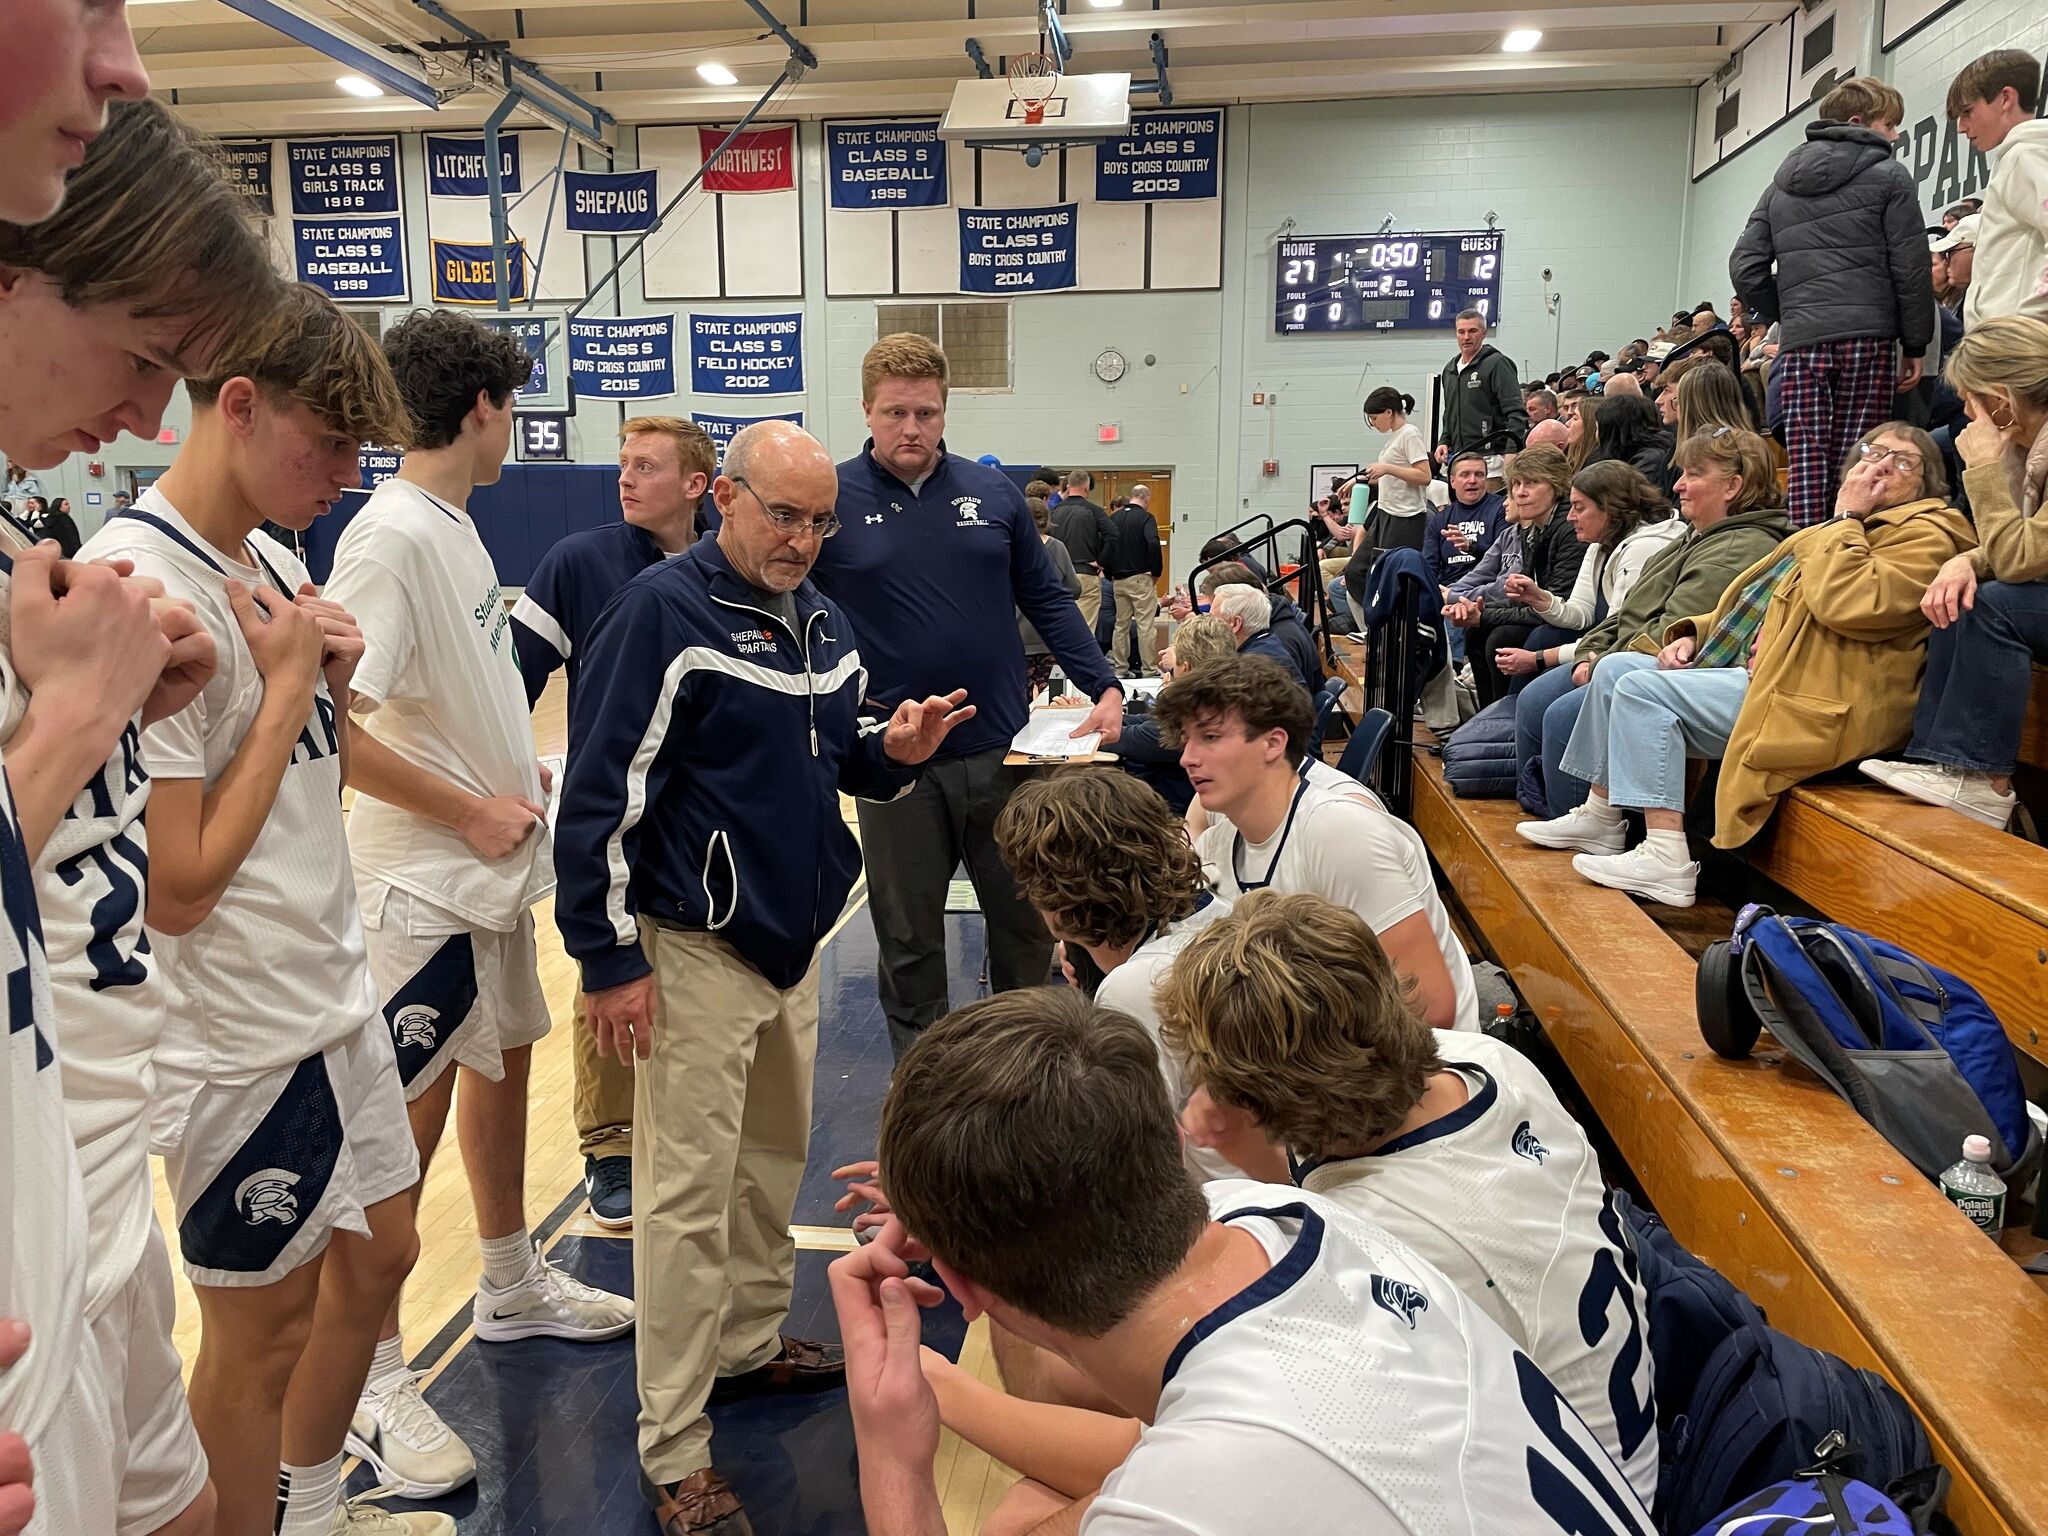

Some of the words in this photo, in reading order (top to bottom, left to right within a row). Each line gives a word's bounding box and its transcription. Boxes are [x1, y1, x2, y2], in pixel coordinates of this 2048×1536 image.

[1145, 120, 1214, 136] CHAMPIONS
[837, 132, 870, 145] STATE
[875, 130, 936, 143] CHAMPIONS
[293, 148, 326, 160] STATE
[331, 146, 390, 159] CHAMPIONS
[1119, 141, 1177, 155] CLASS
[1183, 140, 1196, 153] S
[848, 149, 907, 164] CLASS
[916, 149, 927, 162] S
[304, 163, 363, 177] CLASS
[370, 163, 382, 175] S
[436, 153, 512, 178] LITCHFID
[1104, 161, 1128, 175] BOYS
[1131, 161, 1162, 174] CROSS
[1166, 158, 1209, 172] COUNTRY
[842, 167, 934, 182] BASEBALL
[303, 180, 338, 193] GIRLS
[344, 179, 385, 192] TRACK
[1132, 178, 1180, 193] 2003
[575, 188, 648, 214] SHEPAUG
[871, 188, 907, 200] 1995
[325, 196, 365, 207] 1986
[966, 216, 1002, 230] STATE
[1006, 212, 1069, 229] CHAMPIONS
[302, 228, 335, 240] STATE
[338, 227, 392, 239] CHAMPIONS
[982, 234, 1037, 248] CLASS
[1041, 233, 1054, 246] S
[1282, 243, 1316, 257] HOME
[1461, 237, 1499, 251] GUEST
[315, 245, 367, 258] CLASS
[370, 245, 382, 256] S
[968, 252, 991, 266] BOYS
[995, 252, 1023, 266] CROSS
[1027, 249, 1067, 265] COUNTRY
[1370, 242, 1419, 267] 0:50
[307, 262, 392, 274] BASEBALL
[1285, 260, 1316, 284] 27
[1473, 254, 1496, 279] 12
[333, 280, 368, 290] 1999
[995, 272, 1034, 286] 2014
[1355, 280, 1378, 289] PERIOD
[1380, 275, 1392, 293] 2
[1286, 292, 1306, 300] FOULS
[1331, 291, 1342, 299] TOL
[1395, 289, 1414, 297] FOULS
[1431, 288, 1443, 296] TOL
[1468, 288, 1489, 296] FOULS
[571, 323, 604, 337] STATE
[607, 323, 668, 337] CHAMPIONS
[695, 322, 731, 336] STATE
[733, 321, 797, 336] CHAMPIONS
[586, 342, 638, 356] CLASS
[641, 342, 653, 355] S
[710, 340, 765, 353] CLASS
[770, 339, 782, 352] S
[573, 360, 594, 373] BOYS
[597, 360, 625, 374] CROSS
[627, 358, 666, 373] COUNTRY
[698, 357, 737, 370] FIELD
[741, 356, 794, 371] HOCKEY
[601, 378, 640, 391] 2015
[725, 375, 770, 388] 2002
[697, 421, 733, 435] STATE
[528, 421, 560, 450] 35
[369, 456, 397, 468] CROSS
[1457, 521, 1485, 535] EPAUG
[731, 630, 766, 642] SHEPAU
[737, 641, 777, 654] SPARTANS
[1957, 1198, 1994, 1210] Poland
